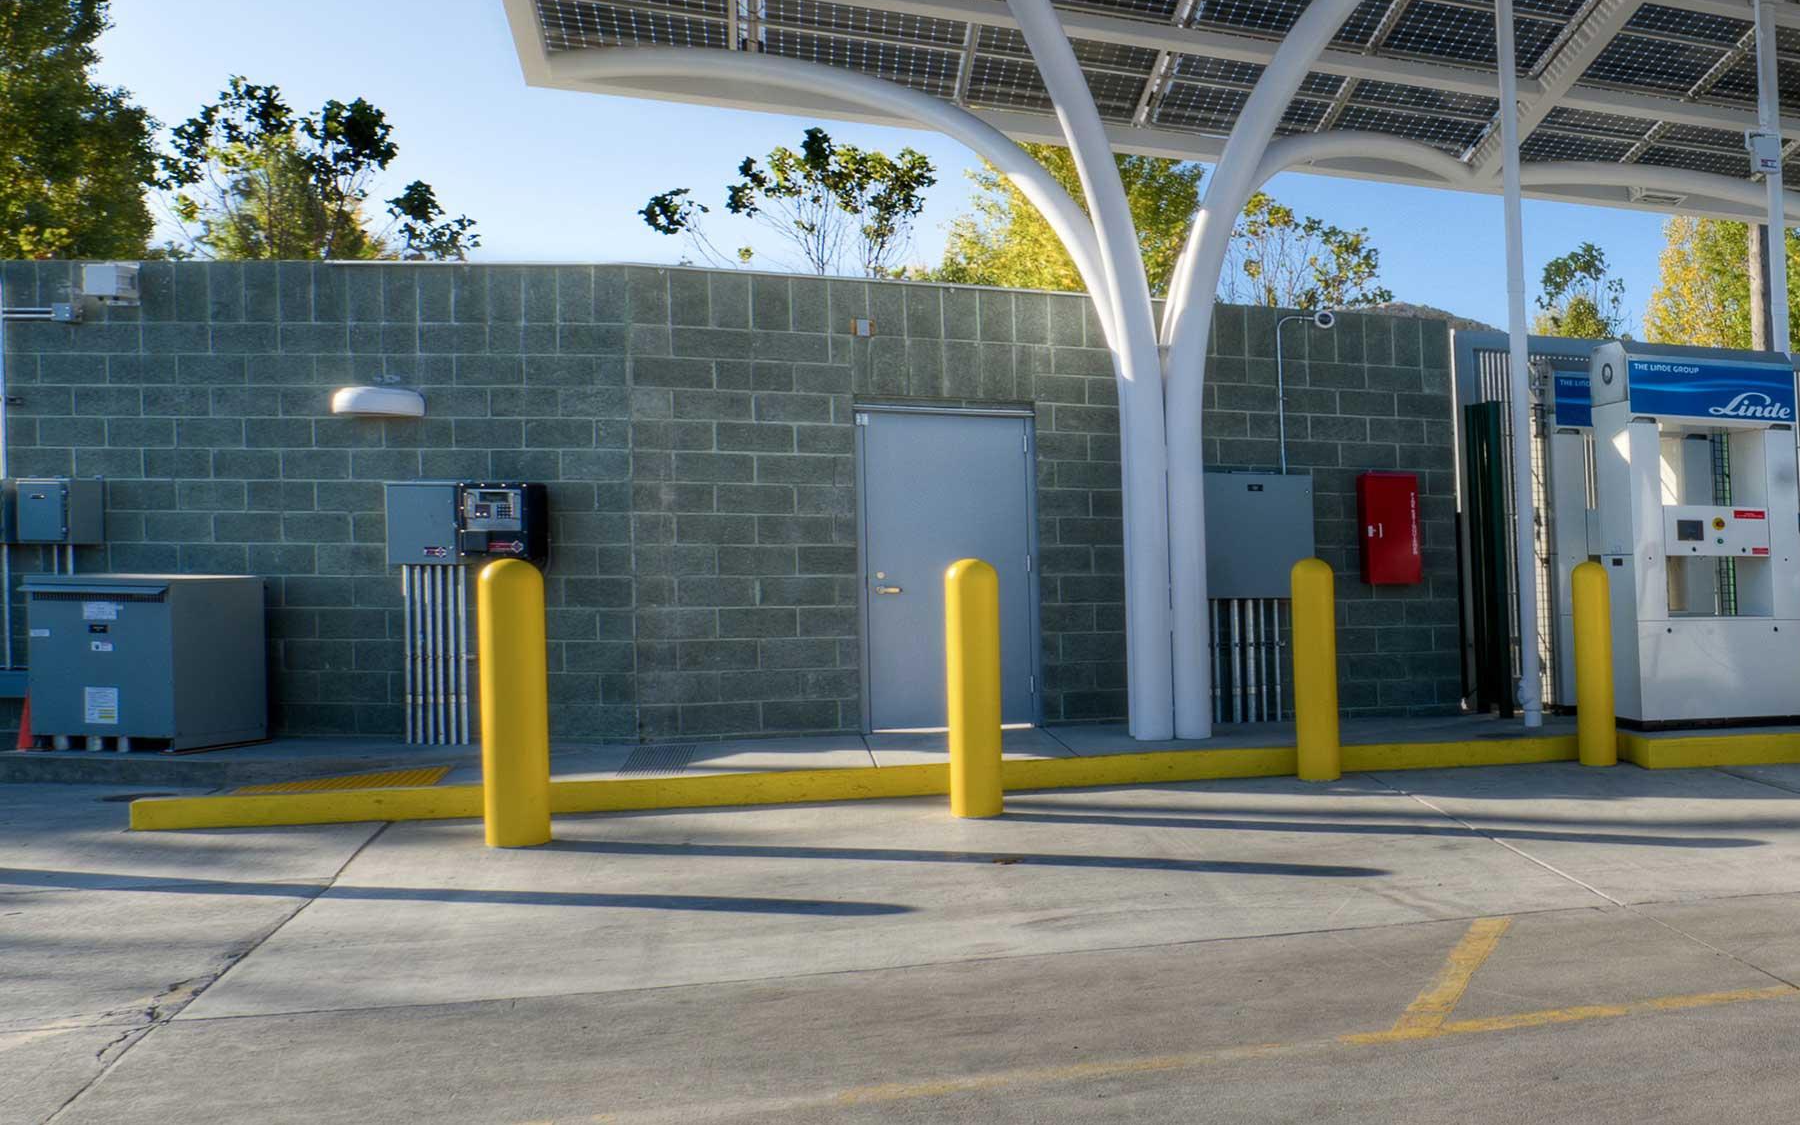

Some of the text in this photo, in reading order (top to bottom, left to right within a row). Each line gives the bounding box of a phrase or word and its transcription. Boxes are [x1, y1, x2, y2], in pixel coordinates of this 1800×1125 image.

[1634, 363, 1700, 374] THE LINDE GROUP
[1560, 379, 1573, 387] THE
[1708, 392, 1791, 419] Linde
